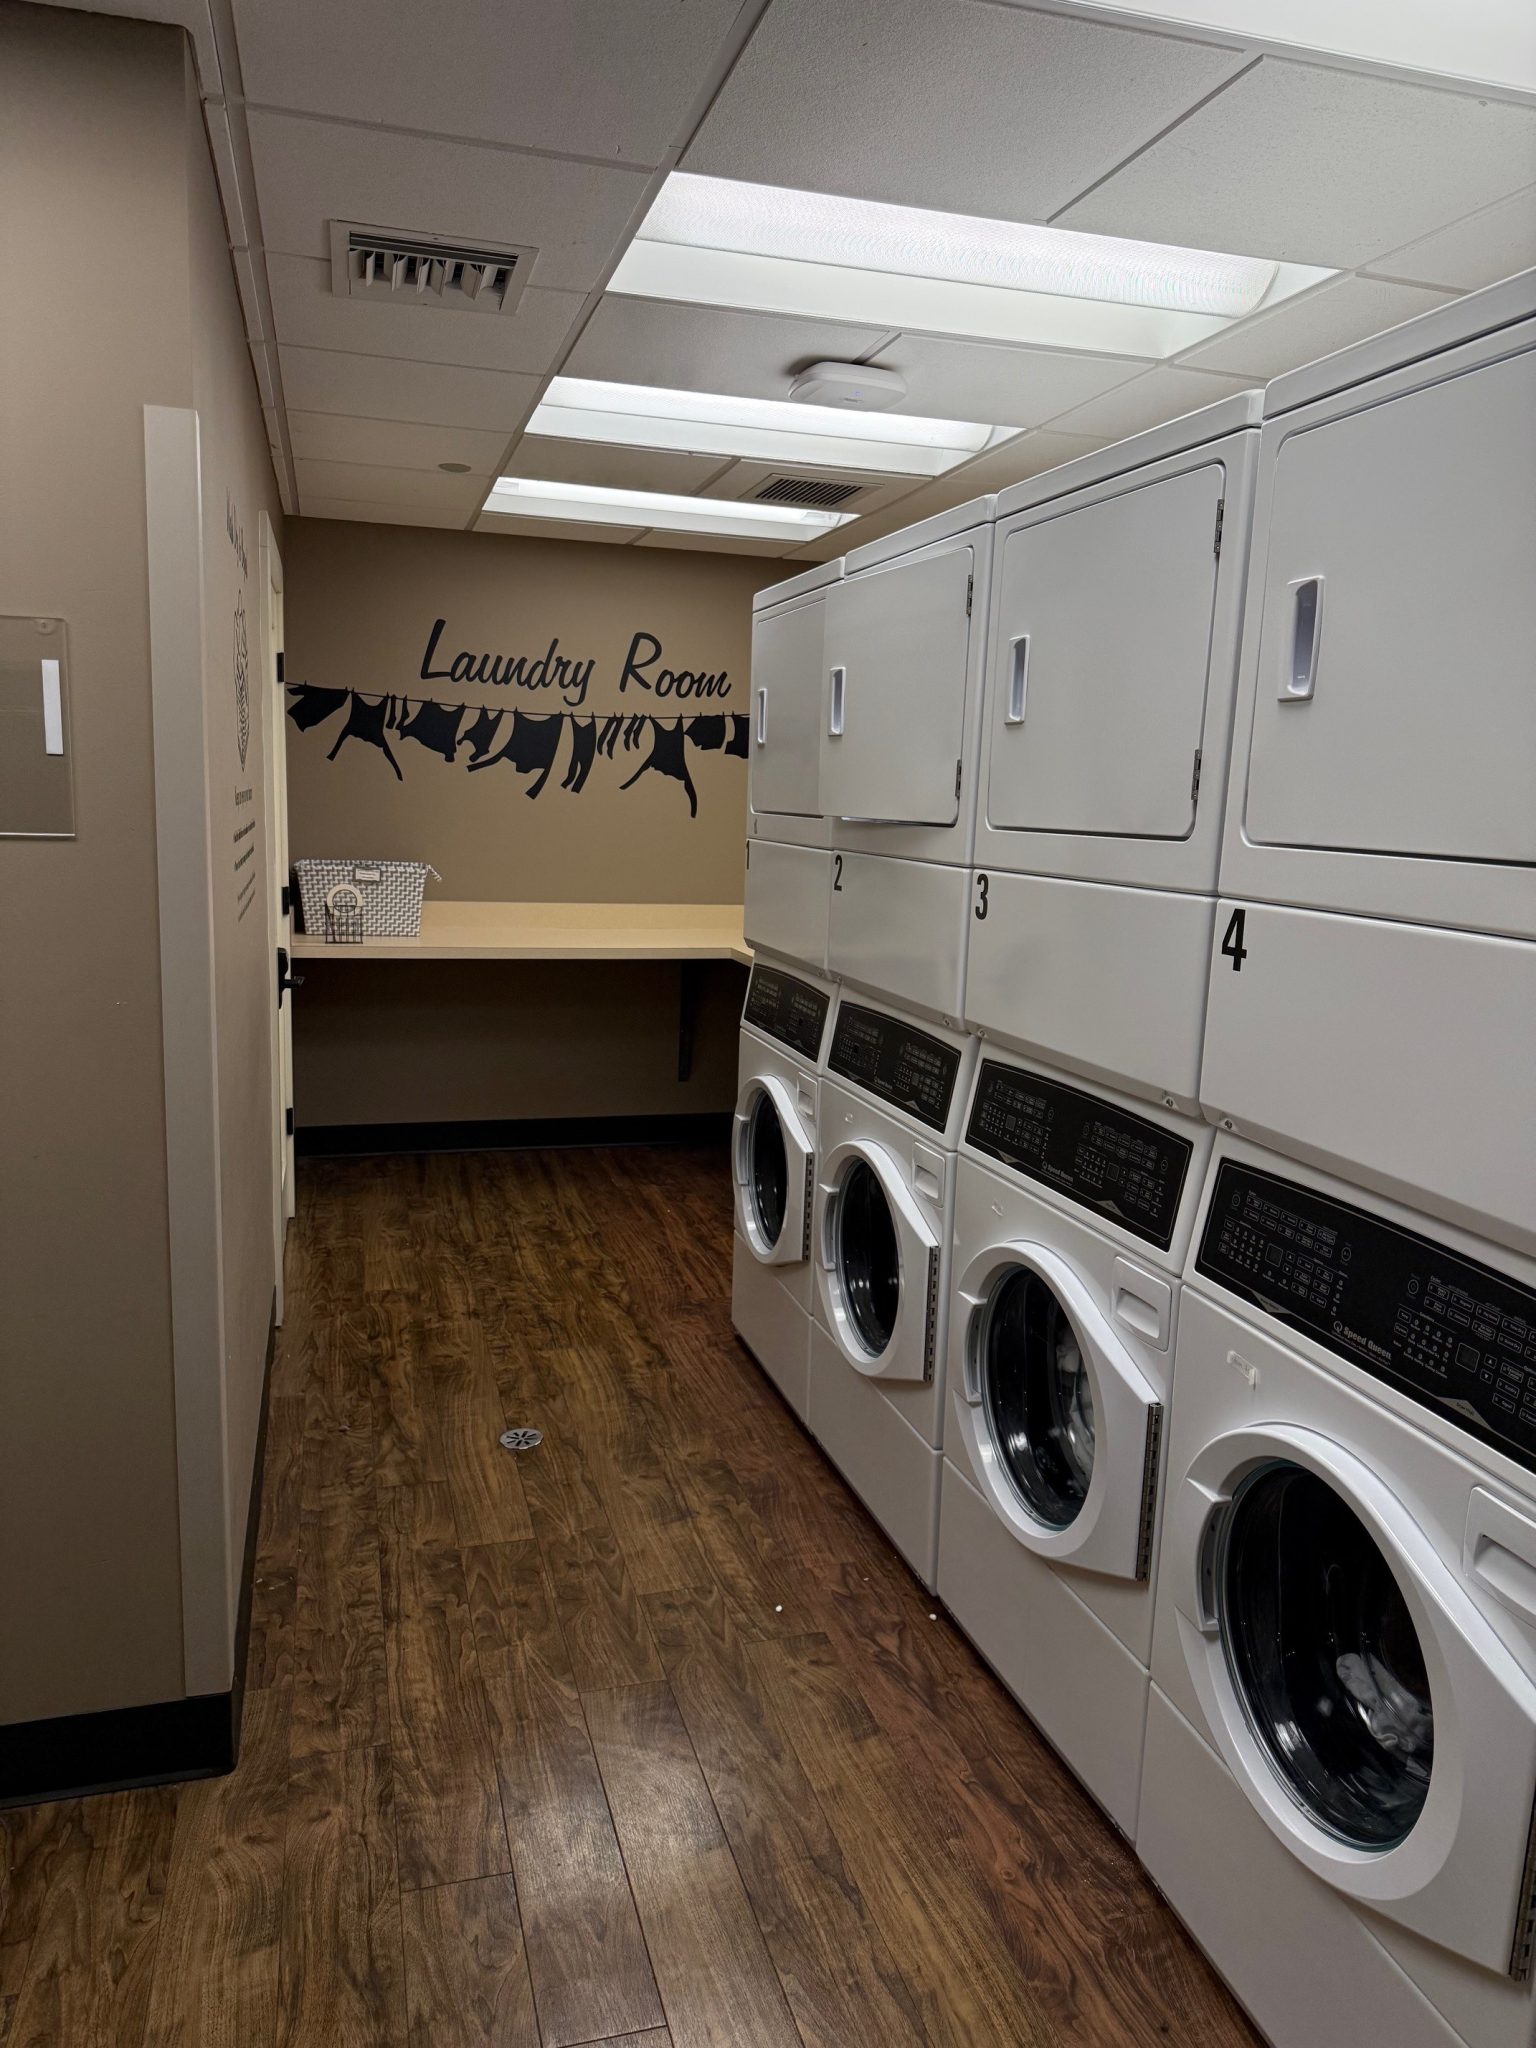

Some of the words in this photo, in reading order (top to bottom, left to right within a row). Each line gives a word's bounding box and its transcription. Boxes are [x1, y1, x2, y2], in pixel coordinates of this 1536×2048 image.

[420, 618, 596, 707] Laundry
[619, 632, 732, 698] Room
[833, 854, 843, 891] 2
[975, 873, 989, 920] 3
[1221, 908, 1247, 972] 4
[1343, 1326, 1367, 1346] Speed
[1367, 1340, 1392, 1360] Queen
